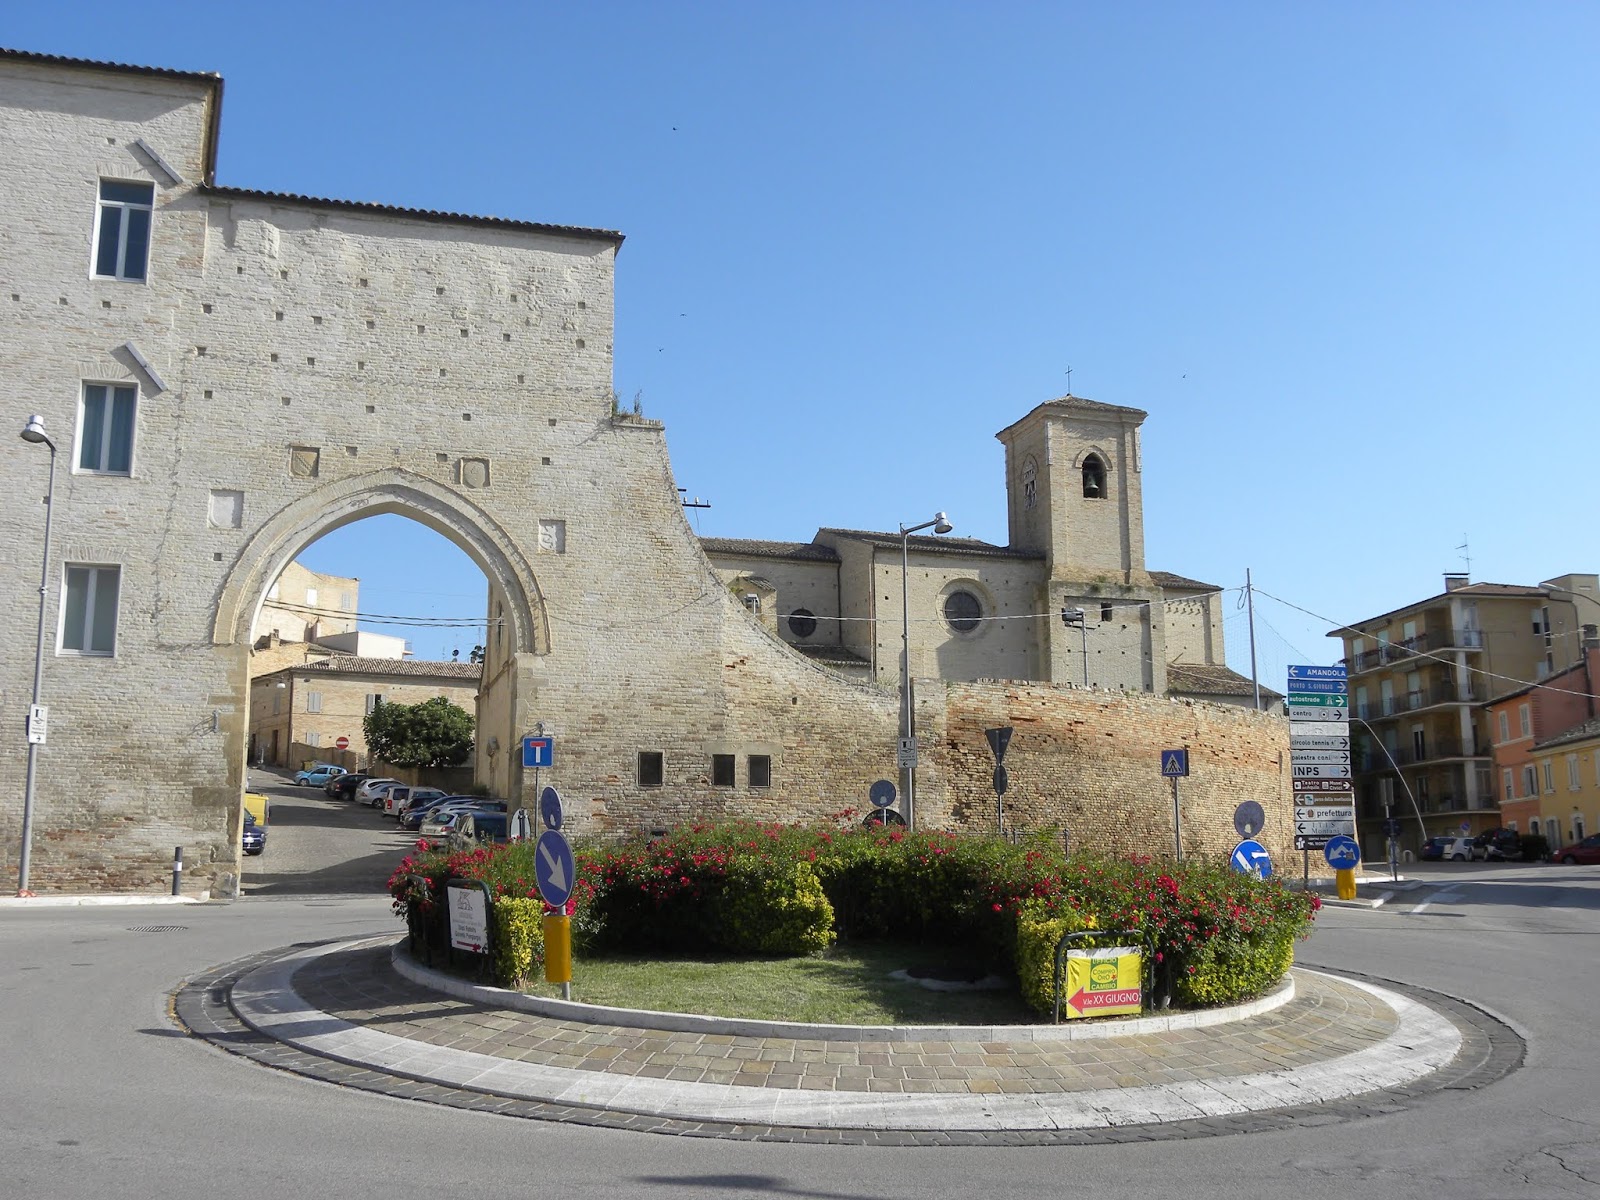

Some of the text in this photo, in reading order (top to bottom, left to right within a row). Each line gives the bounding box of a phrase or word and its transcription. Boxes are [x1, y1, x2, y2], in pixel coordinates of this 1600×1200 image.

[1307, 669, 1346, 677] AMANDOLA
[1294, 766, 1320, 776] INPS
[1317, 809, 1353, 817] prefettura
[1091, 982, 1116, 990] CAMBIO
[1093, 995, 1104, 1004] XX
[1105, 992, 1139, 1003] GIUGNO
